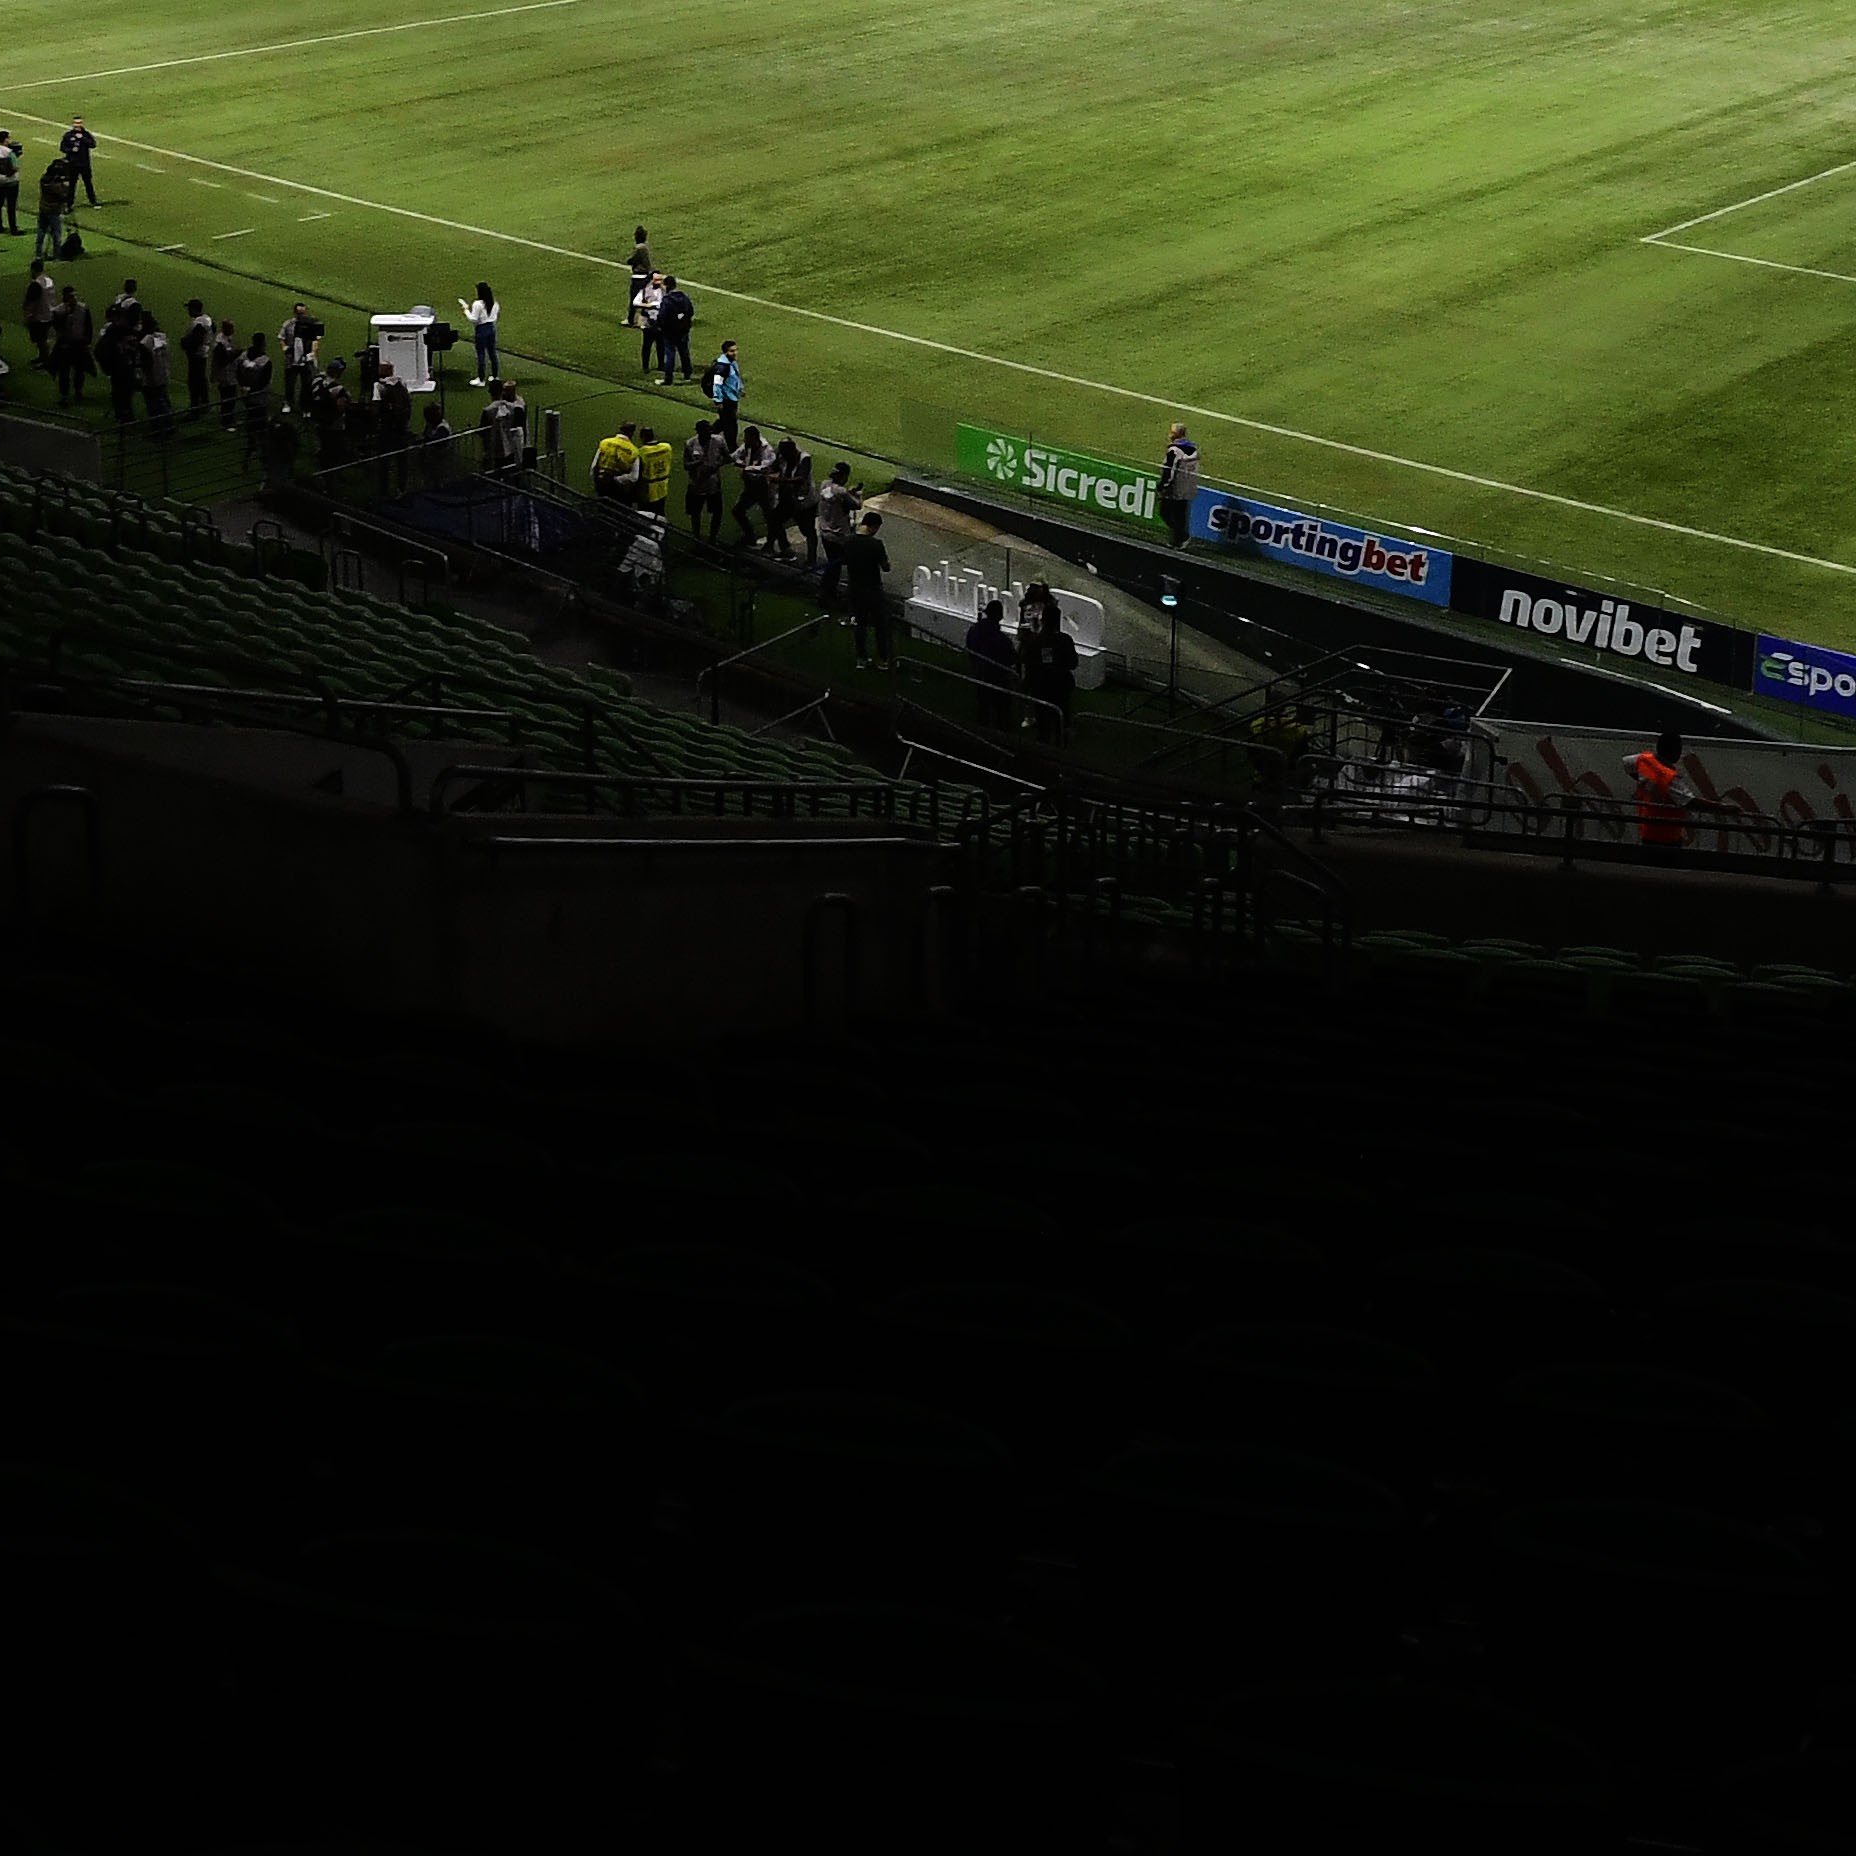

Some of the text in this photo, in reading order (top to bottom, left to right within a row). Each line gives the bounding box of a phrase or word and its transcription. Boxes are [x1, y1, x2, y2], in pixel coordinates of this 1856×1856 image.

[1021, 448, 1158, 519] Sicredi
[1208, 504, 1429, 586] sportingbet
[1498, 588, 1703, 673] novibet
